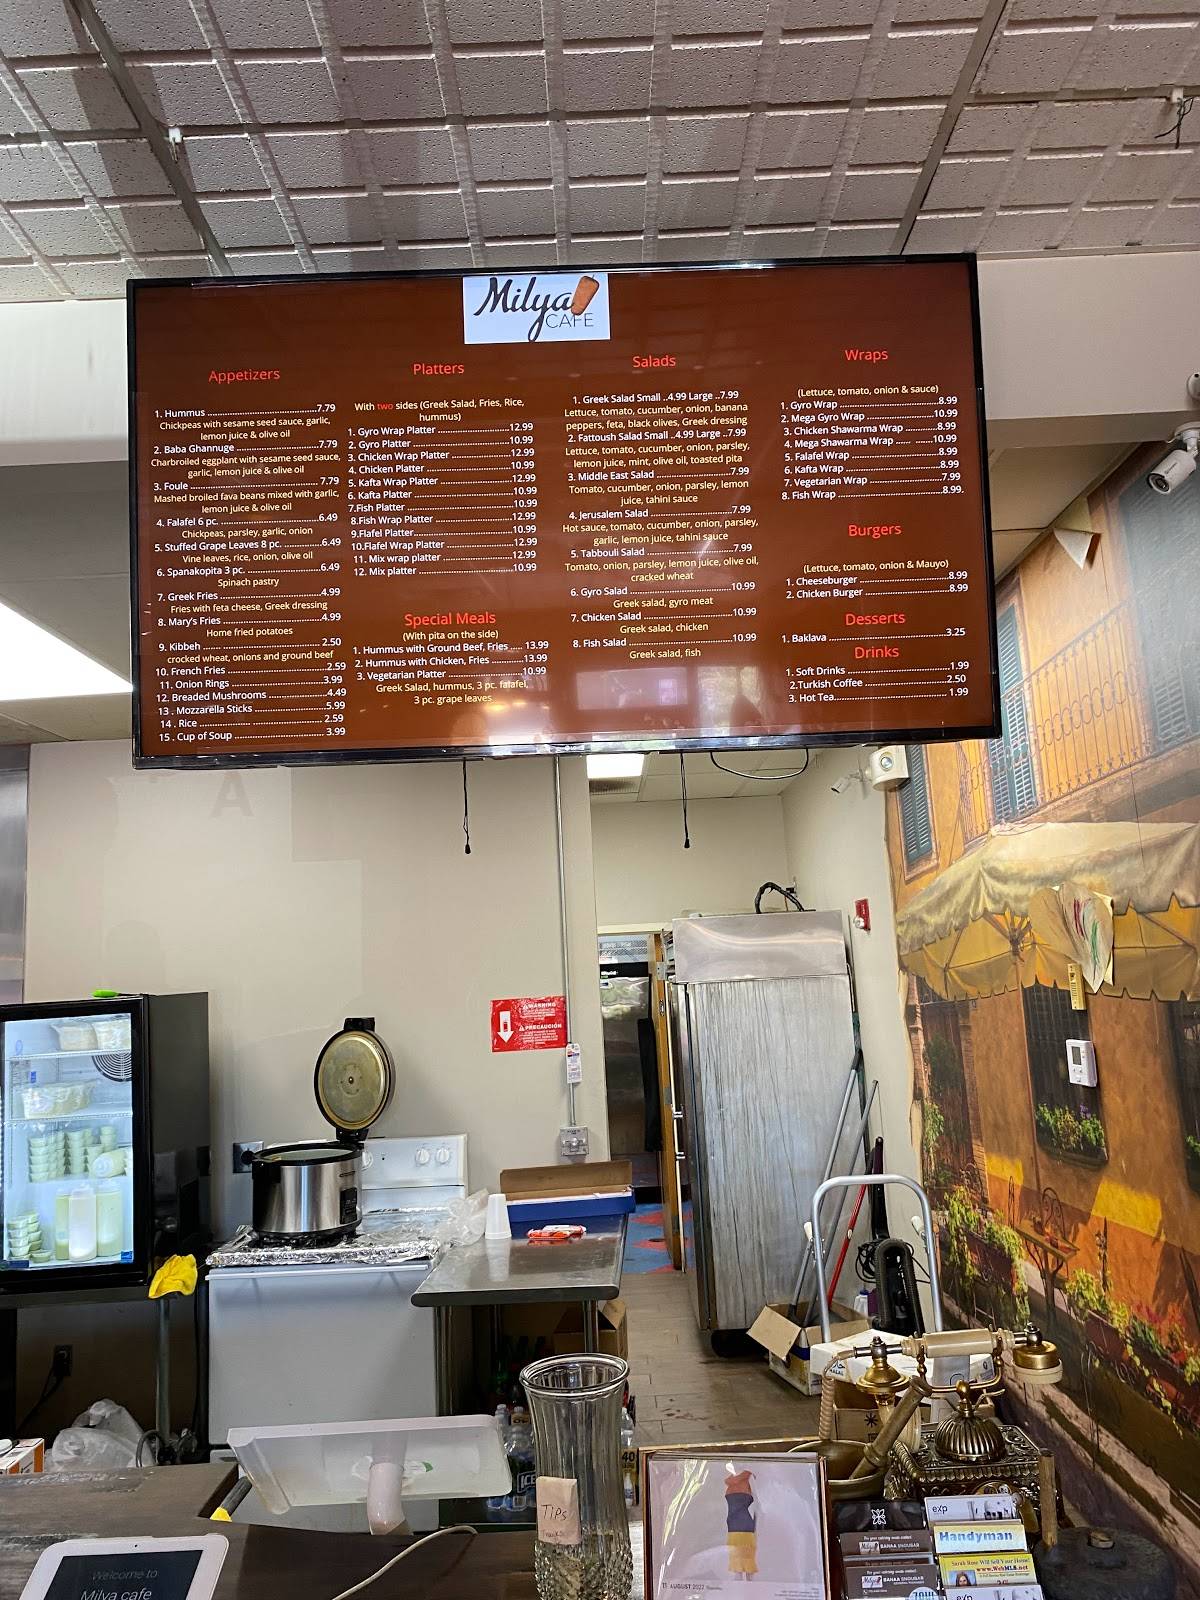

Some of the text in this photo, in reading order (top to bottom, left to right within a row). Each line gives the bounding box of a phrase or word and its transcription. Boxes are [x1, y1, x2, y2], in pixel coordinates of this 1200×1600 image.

[473, 277, 574, 342] Milya
[546, 313, 594, 328] CAFE
[633, 355, 676, 368] Salads
[845, 349, 888, 363] Wraps
[414, 363, 464, 375] Platters
[208, 369, 280, 384] Appetizers
[798, 385, 938, 398] (Lettuce, tomato, onion & sauce)
[573, 396, 580, 404] 1.
[583, 395, 609, 404] Greek
[611, 394, 634, 403] Salad
[637, 393, 660, 402] Small
[689, 392, 713, 402] Large
[354, 402, 375, 411] With
[396, 401, 418, 410] sides
[420, 400, 449, 410] (Greek
[451, 399, 476, 408] Salad,
[479, 399, 502, 407] Fries,
[504, 398, 524, 407] Rice,
[564, 403, 748, 417] Lettuce, tomato, cucumber, onion, banana
[155, 410, 162, 418] 1.
[165, 410, 205, 418] Hummus
[419, 412, 461, 422] hummus)
[781, 415, 789, 423] 2.
[791, 414, 815, 424] Mega
[818, 413, 839, 423] Gyro
[840, 412, 865, 422] Wrap
[160, 421, 202, 431] Chickpeas
[203, 420, 221, 428] with
[223, 420, 255, 428] sesame
[256, 418, 276, 426] seed
[306, 416, 330, 426] garlic,
[348, 428, 356, 436] 1.
[358, 428, 379, 438] Gyro
[381, 427, 404, 436] Wrap
[407, 426, 436, 434] Platter
[784, 427, 792, 436] 3.
[794, 426, 828, 435] Chicken
[831, 425, 877, 434] Shawarma
[879, 424, 904, 434] Wrap
[154, 446, 162, 454] 2.
[164, 445, 186, 454] Baba
[188, 444, 234, 454] Ghannuge
[568, 473, 576, 481] 3.
[578, 472, 608, 481] Middle
[610, 472, 629, 480] East
[631, 470, 654, 479] Salad
[154, 477, 339, 491] 3. Foule 7.79
[348, 492, 356, 500] 6.
[358, 491, 381, 500] Kafta
[383, 490, 412, 498] Platter
[848, 525, 902, 539] Burgers
[154, 544, 163, 552] 5.
[165, 542, 196, 552] Stuffed
[199, 542, 226, 552] Grape
[229, 541, 259, 549] Leaves
[261, 540, 267, 548] 8
[269, 541, 282, 550] pc.
[571, 550, 578, 558] 5.
[580, 548, 618, 558] Tabbouli
[621, 547, 644, 556] Salad
[631, 572, 694, 582] cracked wheat
[157, 593, 166, 602] 7.
[168, 592, 194, 601] Greek
[197, 592, 218, 600] Fries
[786, 591, 794, 599] 2.
[796, 589, 831, 598] Chicken
[833, 589, 863, 598] Burger
[404, 612, 496, 629] Special Meals
[571, 614, 579, 622] 7.
[581, 613, 615, 622] Chicken
[618, 612, 641, 620] Salad
[846, 614, 906, 626] Desserts
[403, 632, 426, 642] (With
[428, 632, 445, 642] pita
[461, 630, 475, 638] the
[478, 630, 498, 639] side)
[782, 635, 790, 643] 1.
[792, 634, 826, 642] Baklava
[159, 638, 341, 652] 9. Kibbeh 2.50
[855, 645, 900, 659] Drinks
[357, 672, 366, 680] 3.
[367, 671, 414, 682] Vegetarian
[417, 670, 446, 678] Platter
[786, 668, 794, 676] 1.
[796, 666, 814, 676] Soft
[816, 666, 846, 675] Drinks
[833, 678, 863, 688] Coffee
[156, 694, 170, 702] 12.
[172, 692, 210, 702] Breaded
[212, 691, 266, 700] Mushrooms
[939, 1531, 1013, 1544] Handyman
[92, 1570, 158, 1580] Welcome to
[121, 1588, 152, 1600] cafe
